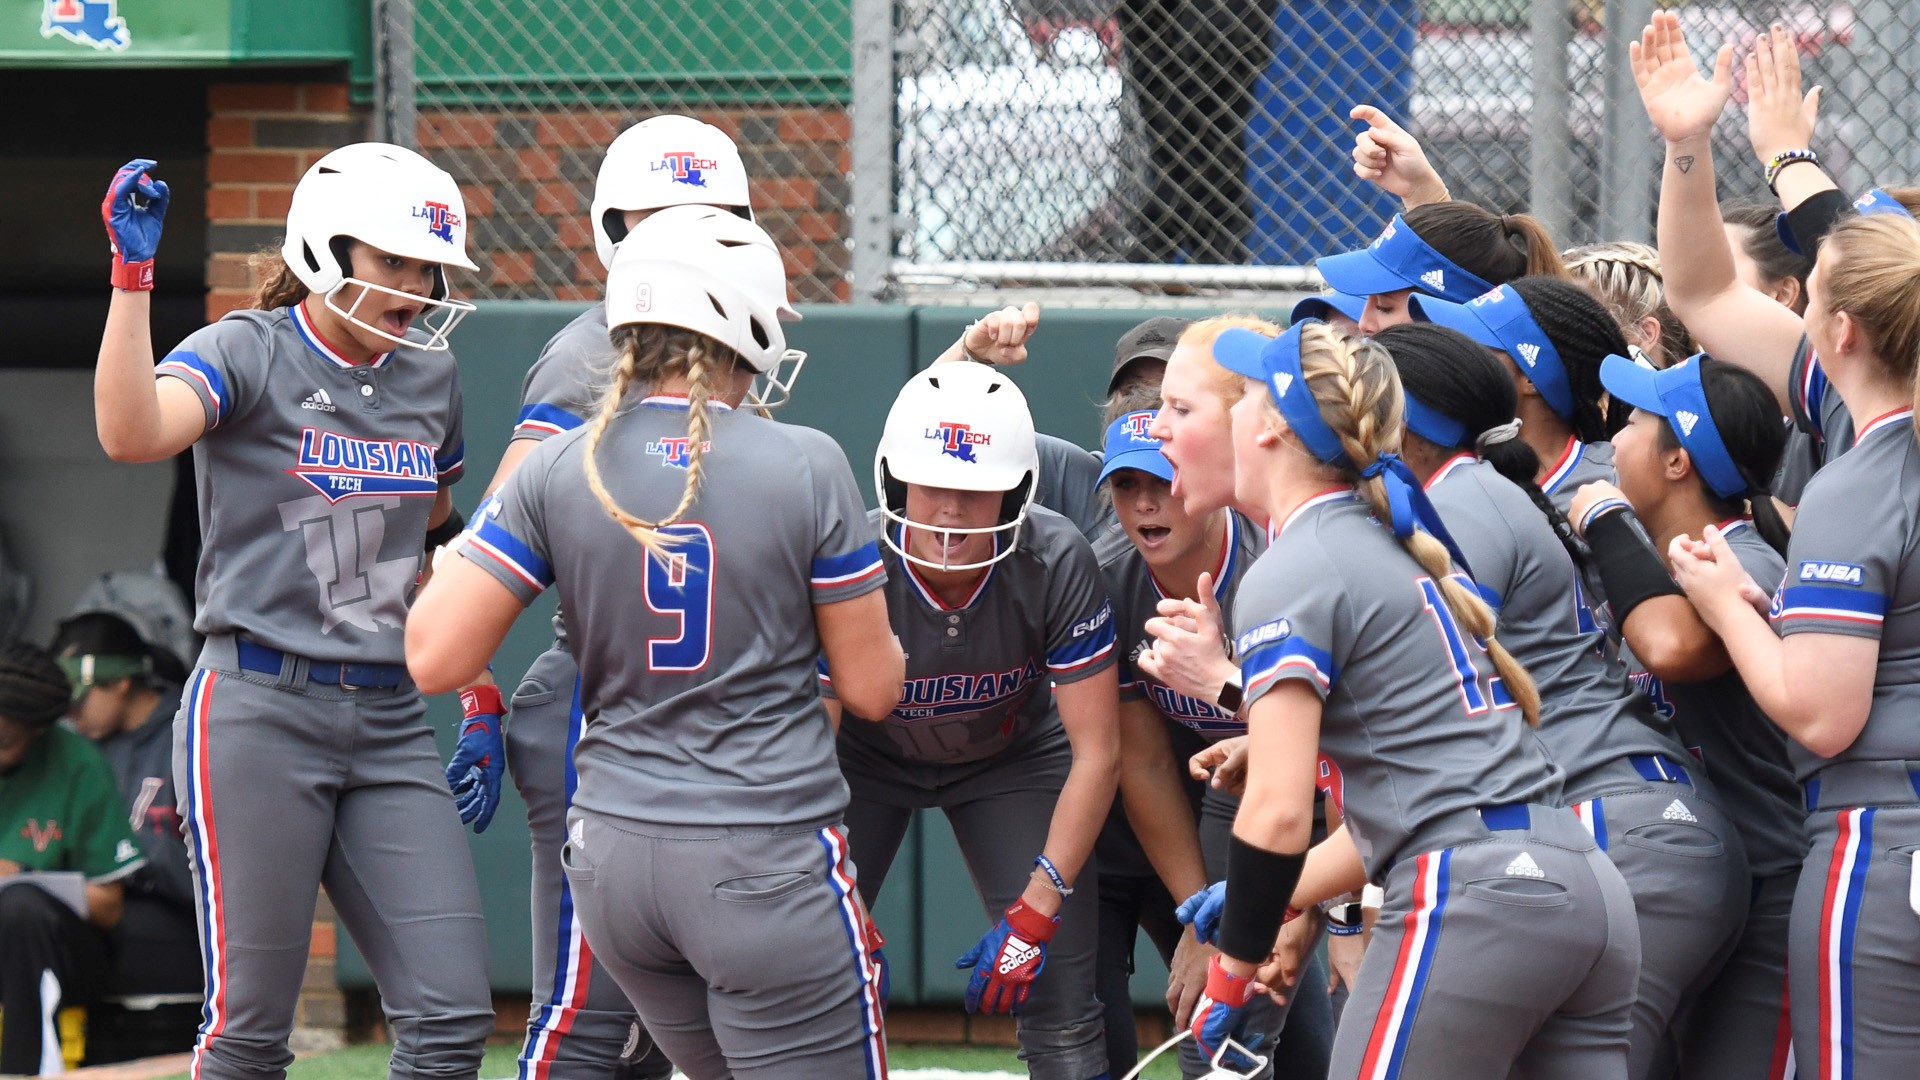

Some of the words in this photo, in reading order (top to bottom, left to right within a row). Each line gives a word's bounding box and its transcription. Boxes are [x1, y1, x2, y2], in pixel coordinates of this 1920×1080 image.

[636, 282, 652, 313] 9
[301, 400, 336, 412] adidas
[298, 427, 438, 482] LOUISIAN
[328, 475, 362, 491] TECH
[642, 520, 717, 674] 9
[899, 656, 1045, 706] OUISIANA
[900, 708, 935, 717] TECH
[999, 945, 1041, 975] adidas
